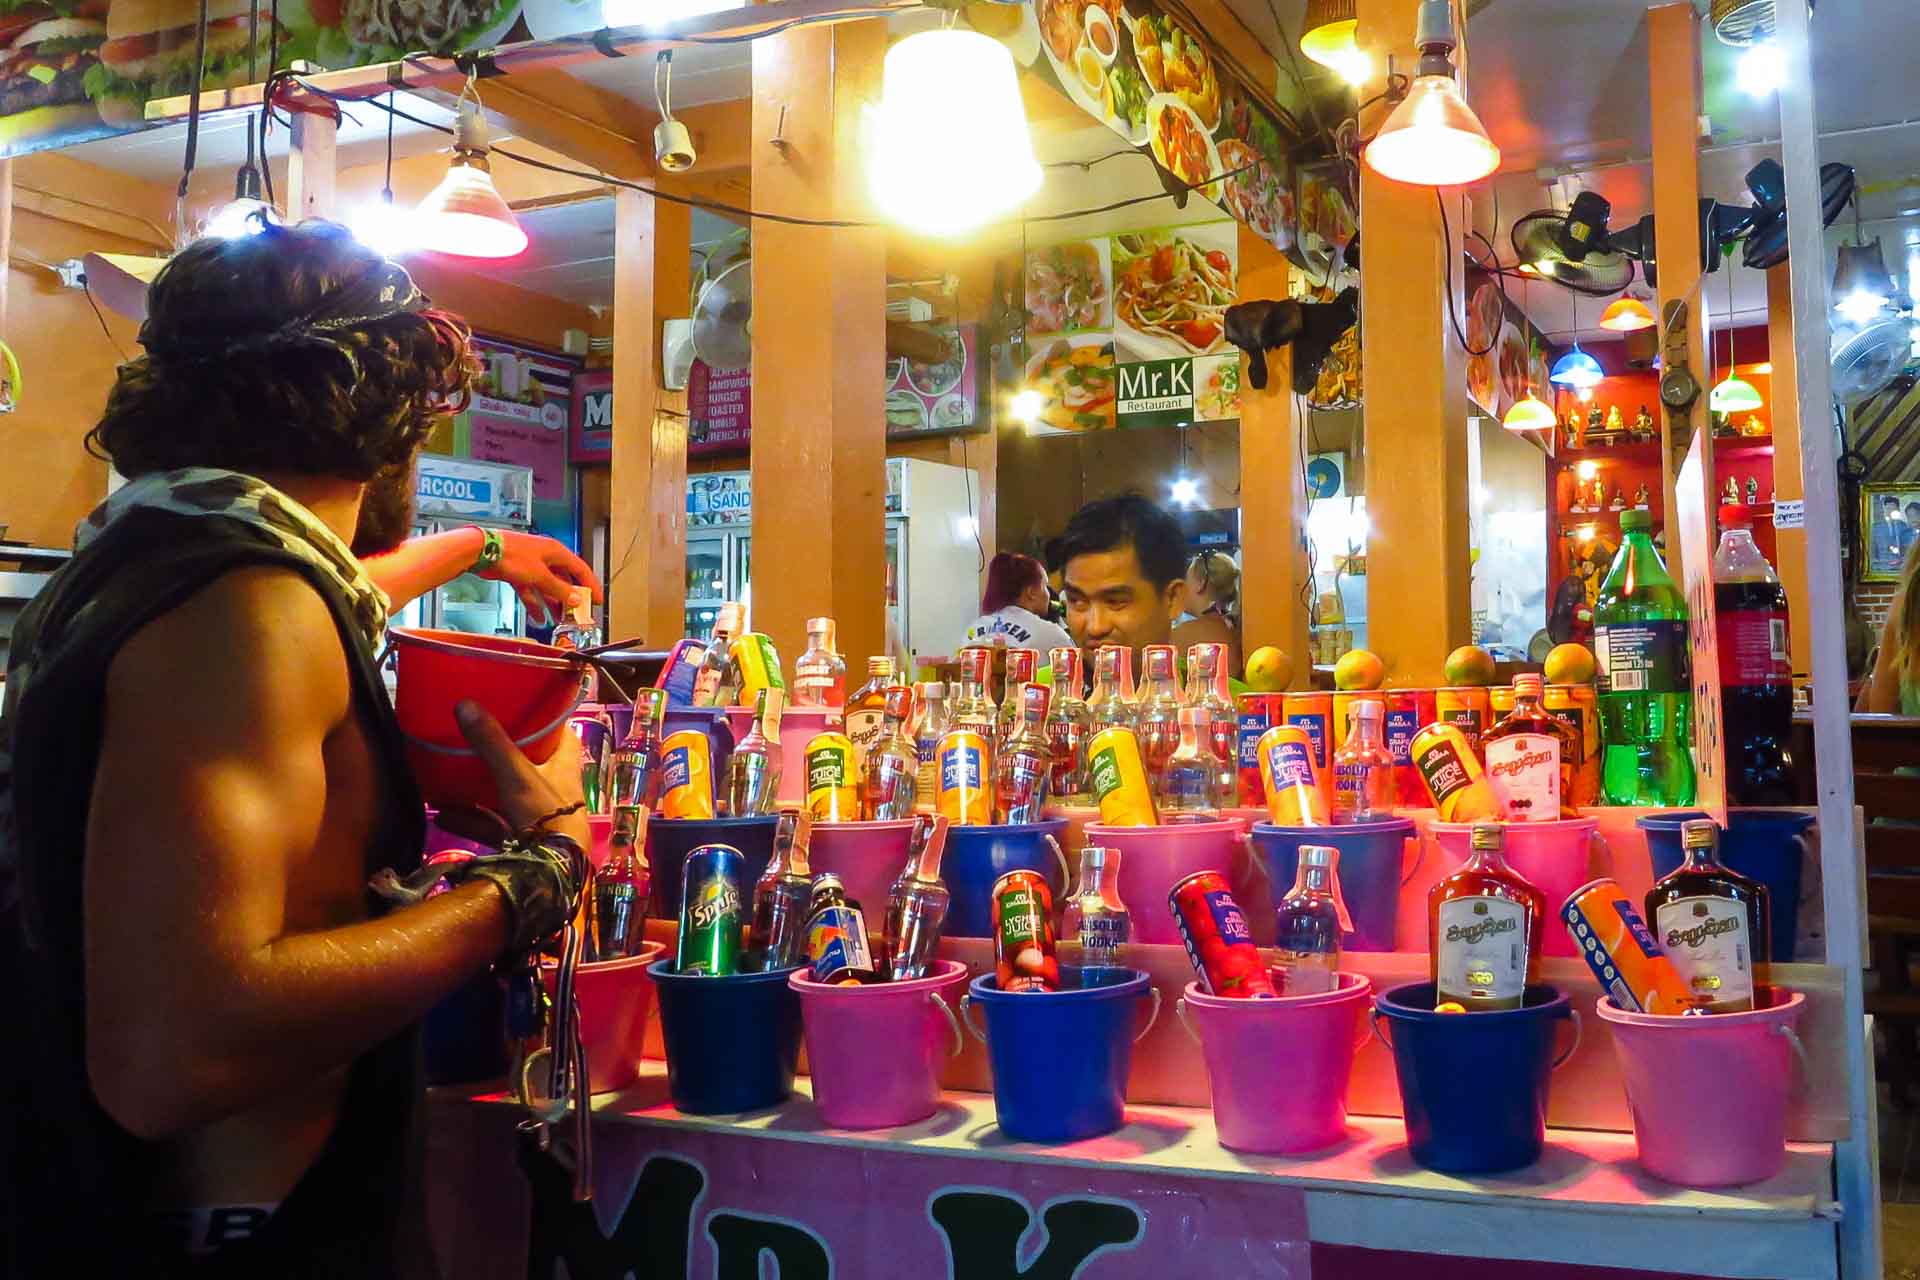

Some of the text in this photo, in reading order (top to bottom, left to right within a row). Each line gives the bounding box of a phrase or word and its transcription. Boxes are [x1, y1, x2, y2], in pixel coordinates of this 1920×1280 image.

[1119, 361, 1192, 399] Mr.K
[1128, 398, 1182, 412] Restaurant
[417, 476, 476, 500] RCOOL
[711, 491, 751, 509] SAND
[1431, 767, 1463, 791] JUICE
[694, 890, 736, 927] Sprite
